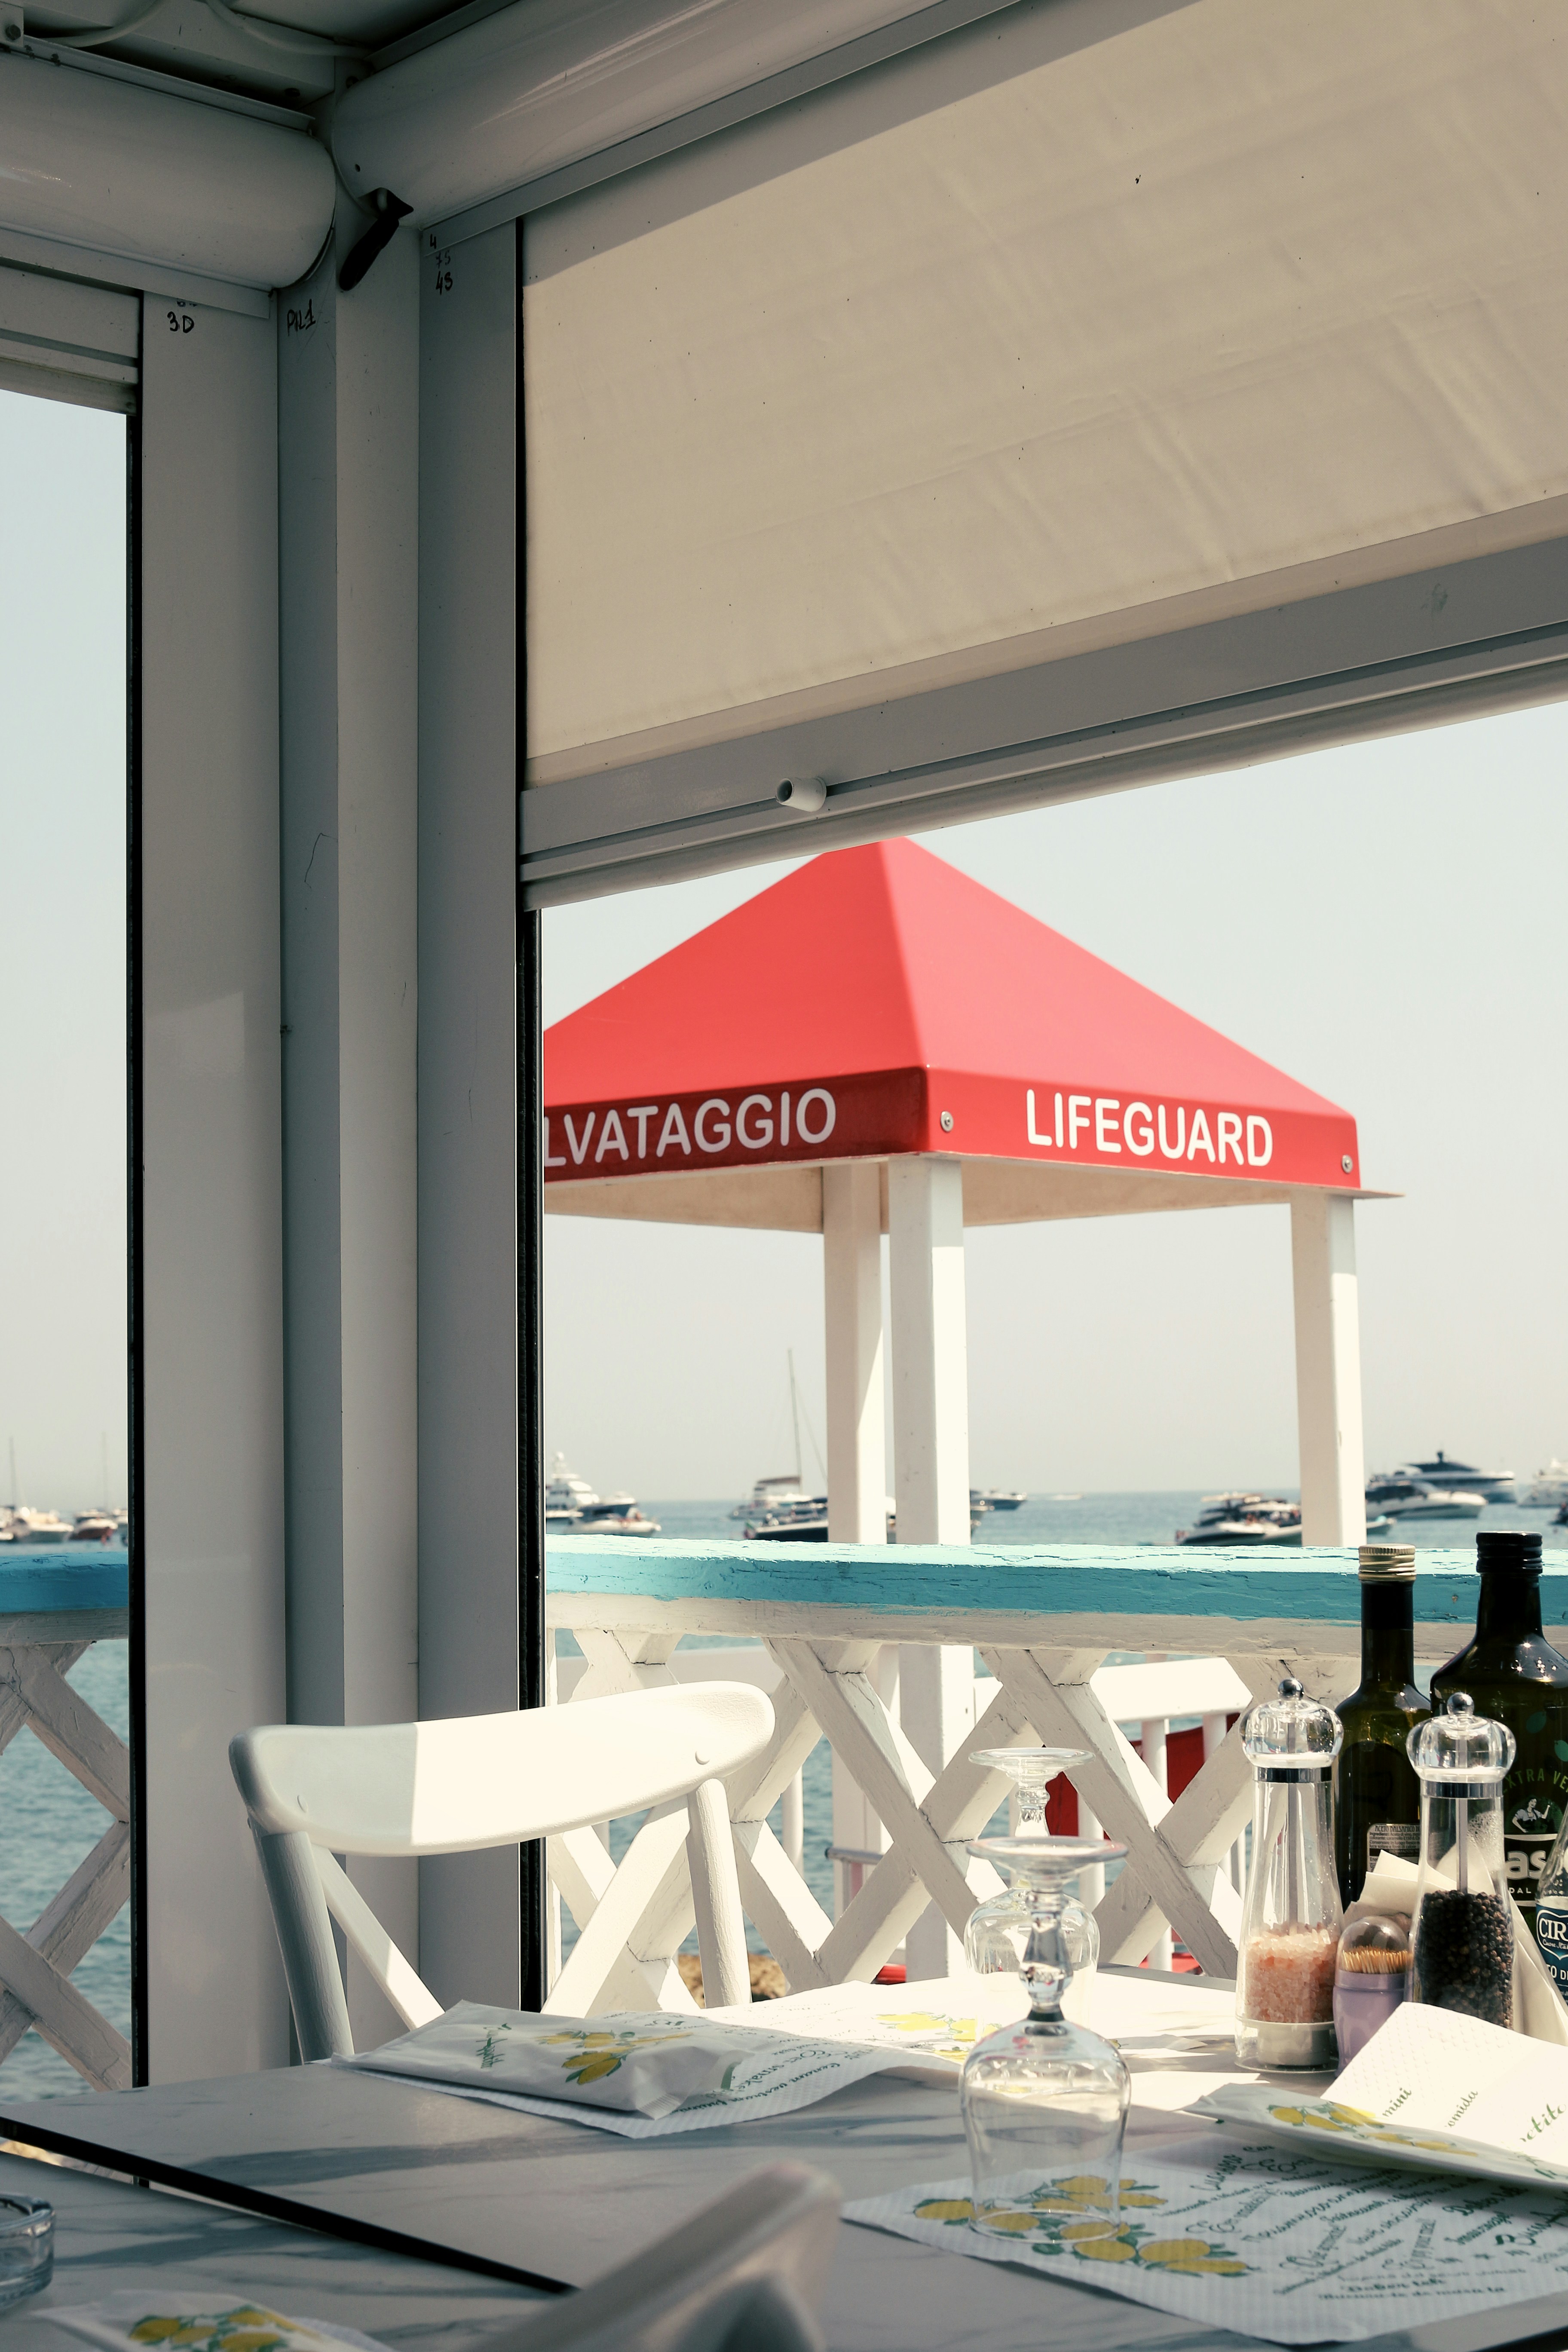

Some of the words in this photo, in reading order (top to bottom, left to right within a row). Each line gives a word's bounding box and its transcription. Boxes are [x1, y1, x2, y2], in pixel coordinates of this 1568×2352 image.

[167, 311, 194, 334] 3D
[544, 1087, 836, 1167] LVATAGGIO
[1026, 1089, 1273, 1167] LIFEGUARD
[1504, 1768, 1544, 1793] XTRA
[1539, 1917, 1568, 1942] CIR
[1445, 2091, 1478, 2128] omida
